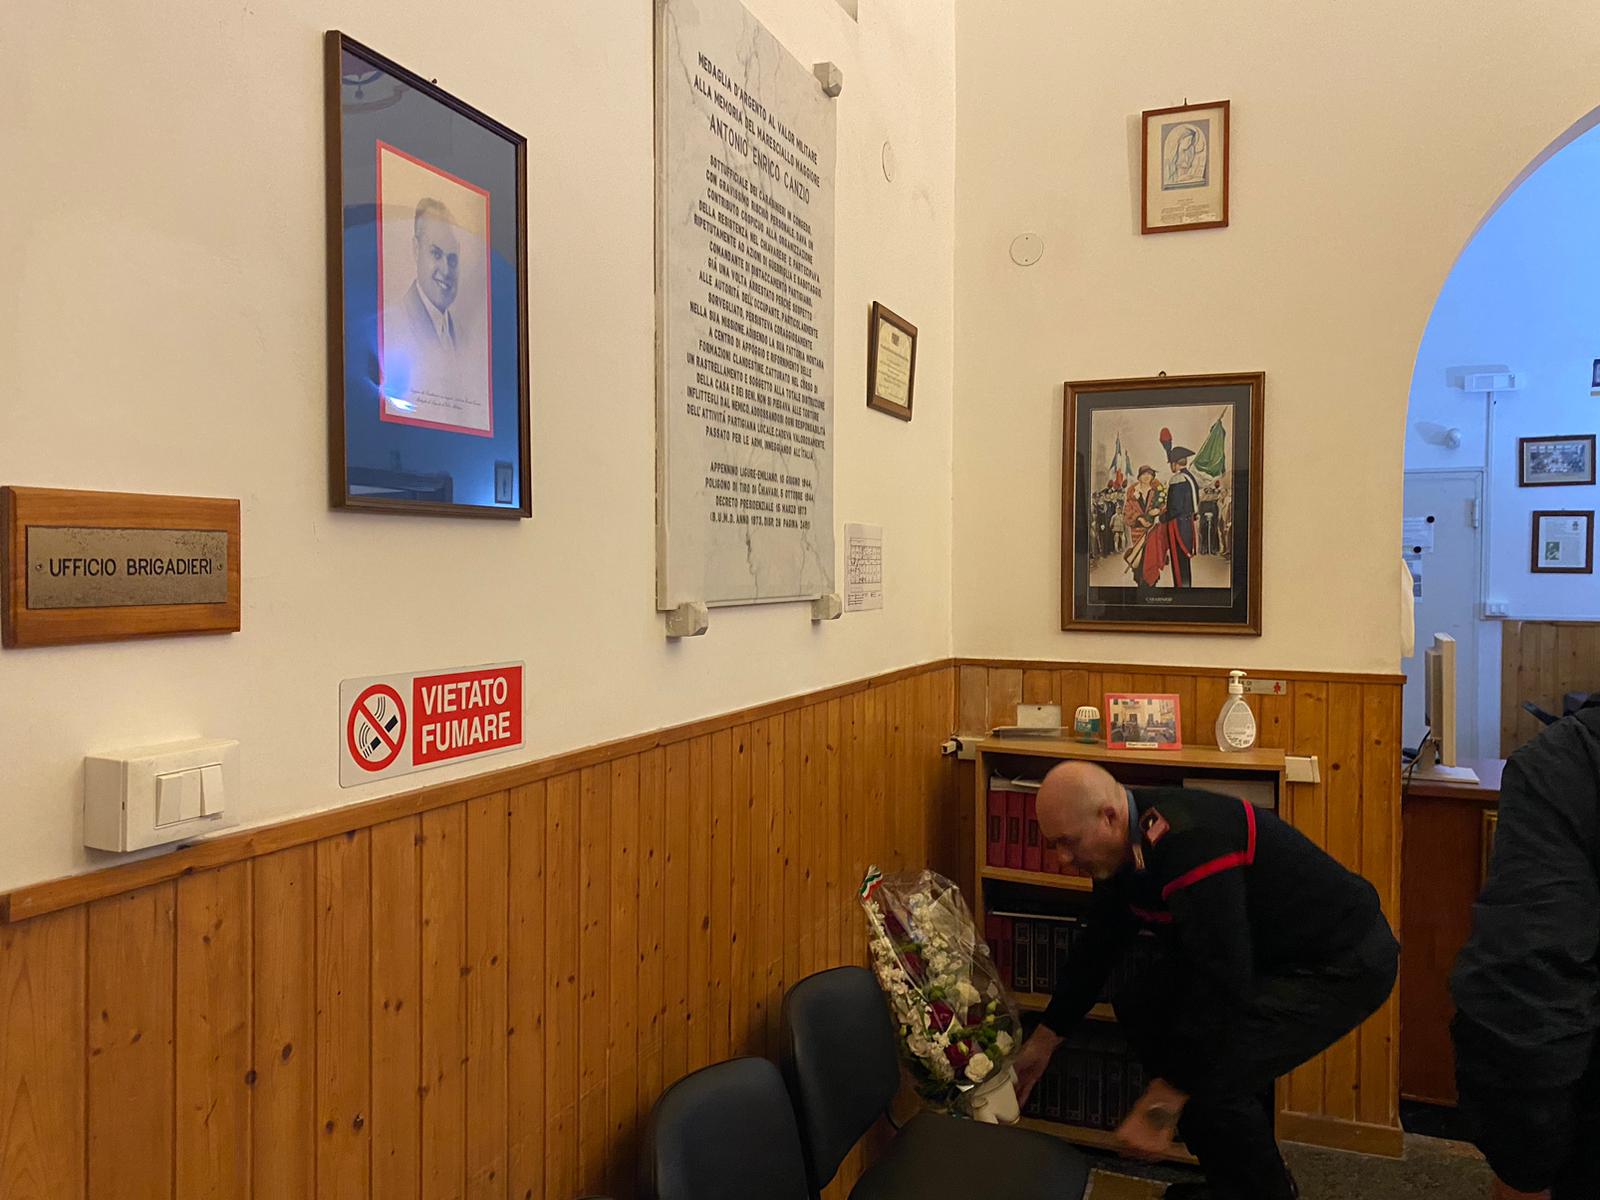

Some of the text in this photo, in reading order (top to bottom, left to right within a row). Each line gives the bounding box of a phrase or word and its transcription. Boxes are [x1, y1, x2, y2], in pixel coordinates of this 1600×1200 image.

[693, 73, 820, 188] ALLA MEMORIA DEL MARESCIALLO MAGGIORE
[698, 51, 732, 93] MEDAGLIA
[733, 82, 767, 122] D'ARGENTO
[777, 121, 795, 146] VALOR
[796, 136, 817, 166] MILITARE
[709, 112, 809, 205] ANTONIO ENRICO CANZIO
[706, 169, 717, 186] CON
[719, 178, 749, 208] GRAVISSIMO
[710, 154, 748, 191] SOTTUFFICIALE
[758, 189, 786, 218] CARABINIERI
[694, 214, 737, 249] RIPETUTAMENTE
[746, 245, 761, 263] AZIONI
[699, 200, 716, 220] DELLA
[718, 211, 748, 240] RESISTENZA
[750, 231, 758, 246] NEL
[793, 258, 820, 284] PARTECIPAVA
[707, 187, 813, 265] CONTRIBUTO COSPICUO ALLA ORGANIZZAZIONE
[709, 241, 744, 270] COMANDANTE
[751, 264, 787, 293] DISTACCAMENTO
[718, 263, 730, 279] UNA
[731, 270, 747, 288] VOLTA
[749, 279, 774, 302] ARRESTATO
[699, 270, 712, 287] ALLE
[781, 311, 818, 339] PARTICOLARMENTE
[689, 301, 707, 319] NELLA
[709, 310, 720, 325] SUA
[786, 344, 805, 361] FATTORIA
[714, 329, 734, 347] CENTRO
[742, 340, 765, 359] APPOGGIO
[770, 352, 799, 373] RIFORNIMENTO
[745, 310, 773, 332] PERSISTEVA
[774, 323, 812, 350] CORAGGIOSAMENTE
[696, 356, 743, 383] RASTRELLAMENTO
[749, 375, 773, 393] SOGGETTO
[774, 384, 785, 397] ALLA
[786, 388, 801, 402] TOTALE
[698, 339, 731, 362] FORMAZIONI
[765, 365, 790, 384] CATTURATO
[687, 386, 719, 406] INFLITTEGLI
[719, 396, 730, 409] DAL
[696, 373, 713, 388] DELLA
[715, 379, 730, 394] CASA
[757, 393, 766, 405] NON
[773, 398, 790, 413] PIEGAVA
[792, 405, 801, 416] ALLE
[705, 426, 730, 442] PASSATO
[731, 432, 741, 444] PER
[727, 414, 756, 432] PARTIGIANA
[705, 478, 730, 491] POLIGONO
[739, 483, 750, 494] TIRO
[785, 490, 803, 501] OTTOBRE
[710, 461, 738, 476] APPENNINO
[715, 495, 738, 508] DECRETO
[740, 498, 774, 512] PRESIDENZIALE
[782, 503, 796, 514] MARZO
[736, 514, 749, 525] ANNO
[782, 518, 798, 529] PAGINA
[49, 558, 212, 577] UFFICIO BRIGADIERI
[421, 676, 508, 716] VIETATO
[421, 711, 511, 755] FUMARE
